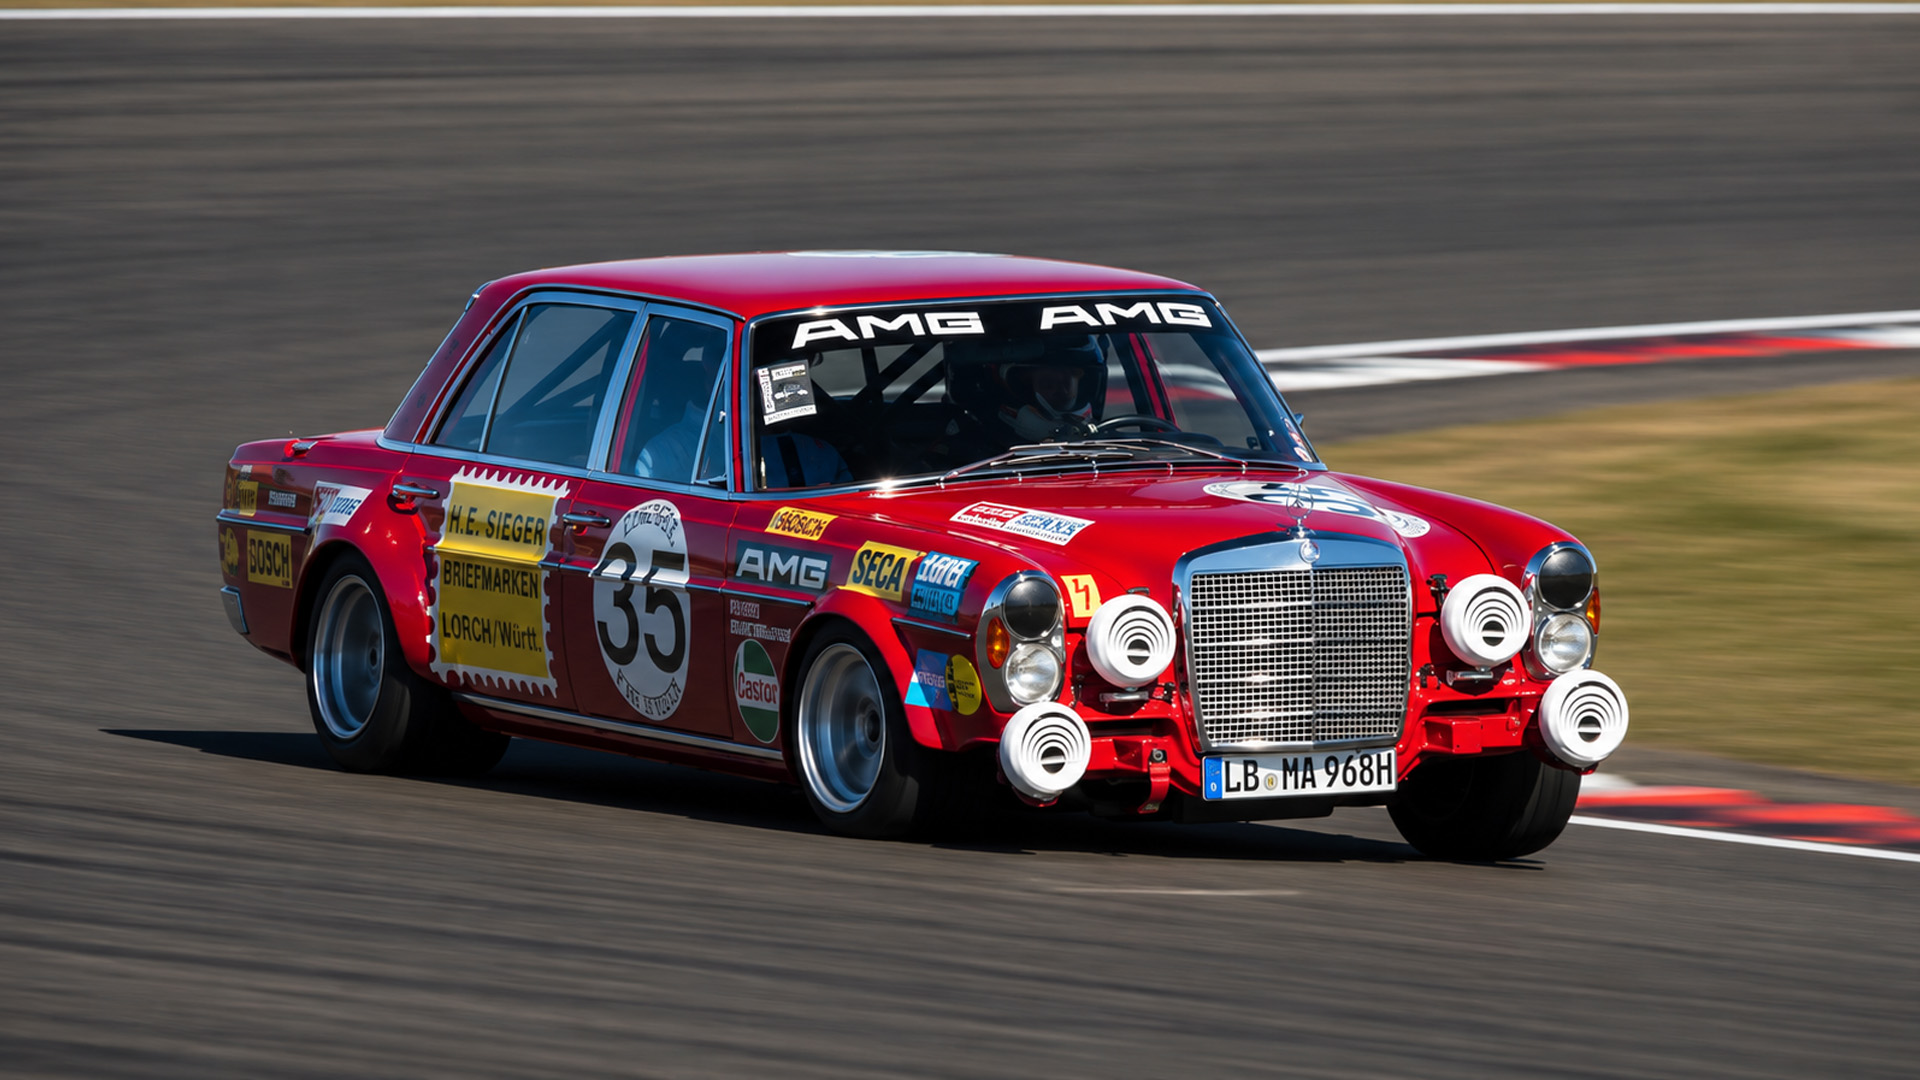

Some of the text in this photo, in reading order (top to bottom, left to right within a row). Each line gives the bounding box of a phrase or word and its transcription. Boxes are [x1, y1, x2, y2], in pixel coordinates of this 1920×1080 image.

[791, 311, 985, 350] AMG
[1039, 302, 1213, 331] AMG
[449, 505, 545, 546] H.E. SIEGER
[249, 538, 291, 579] BOSCH
[443, 559, 539, 599] BRIEFMARKEN
[736, 548, 827, 590] AMG
[852, 549, 907, 593] SECA
[593, 542, 686, 674] 35
[442, 611, 542, 653] LORCH/Württ.
[1225, 753, 1392, 793] LB MA 968H
